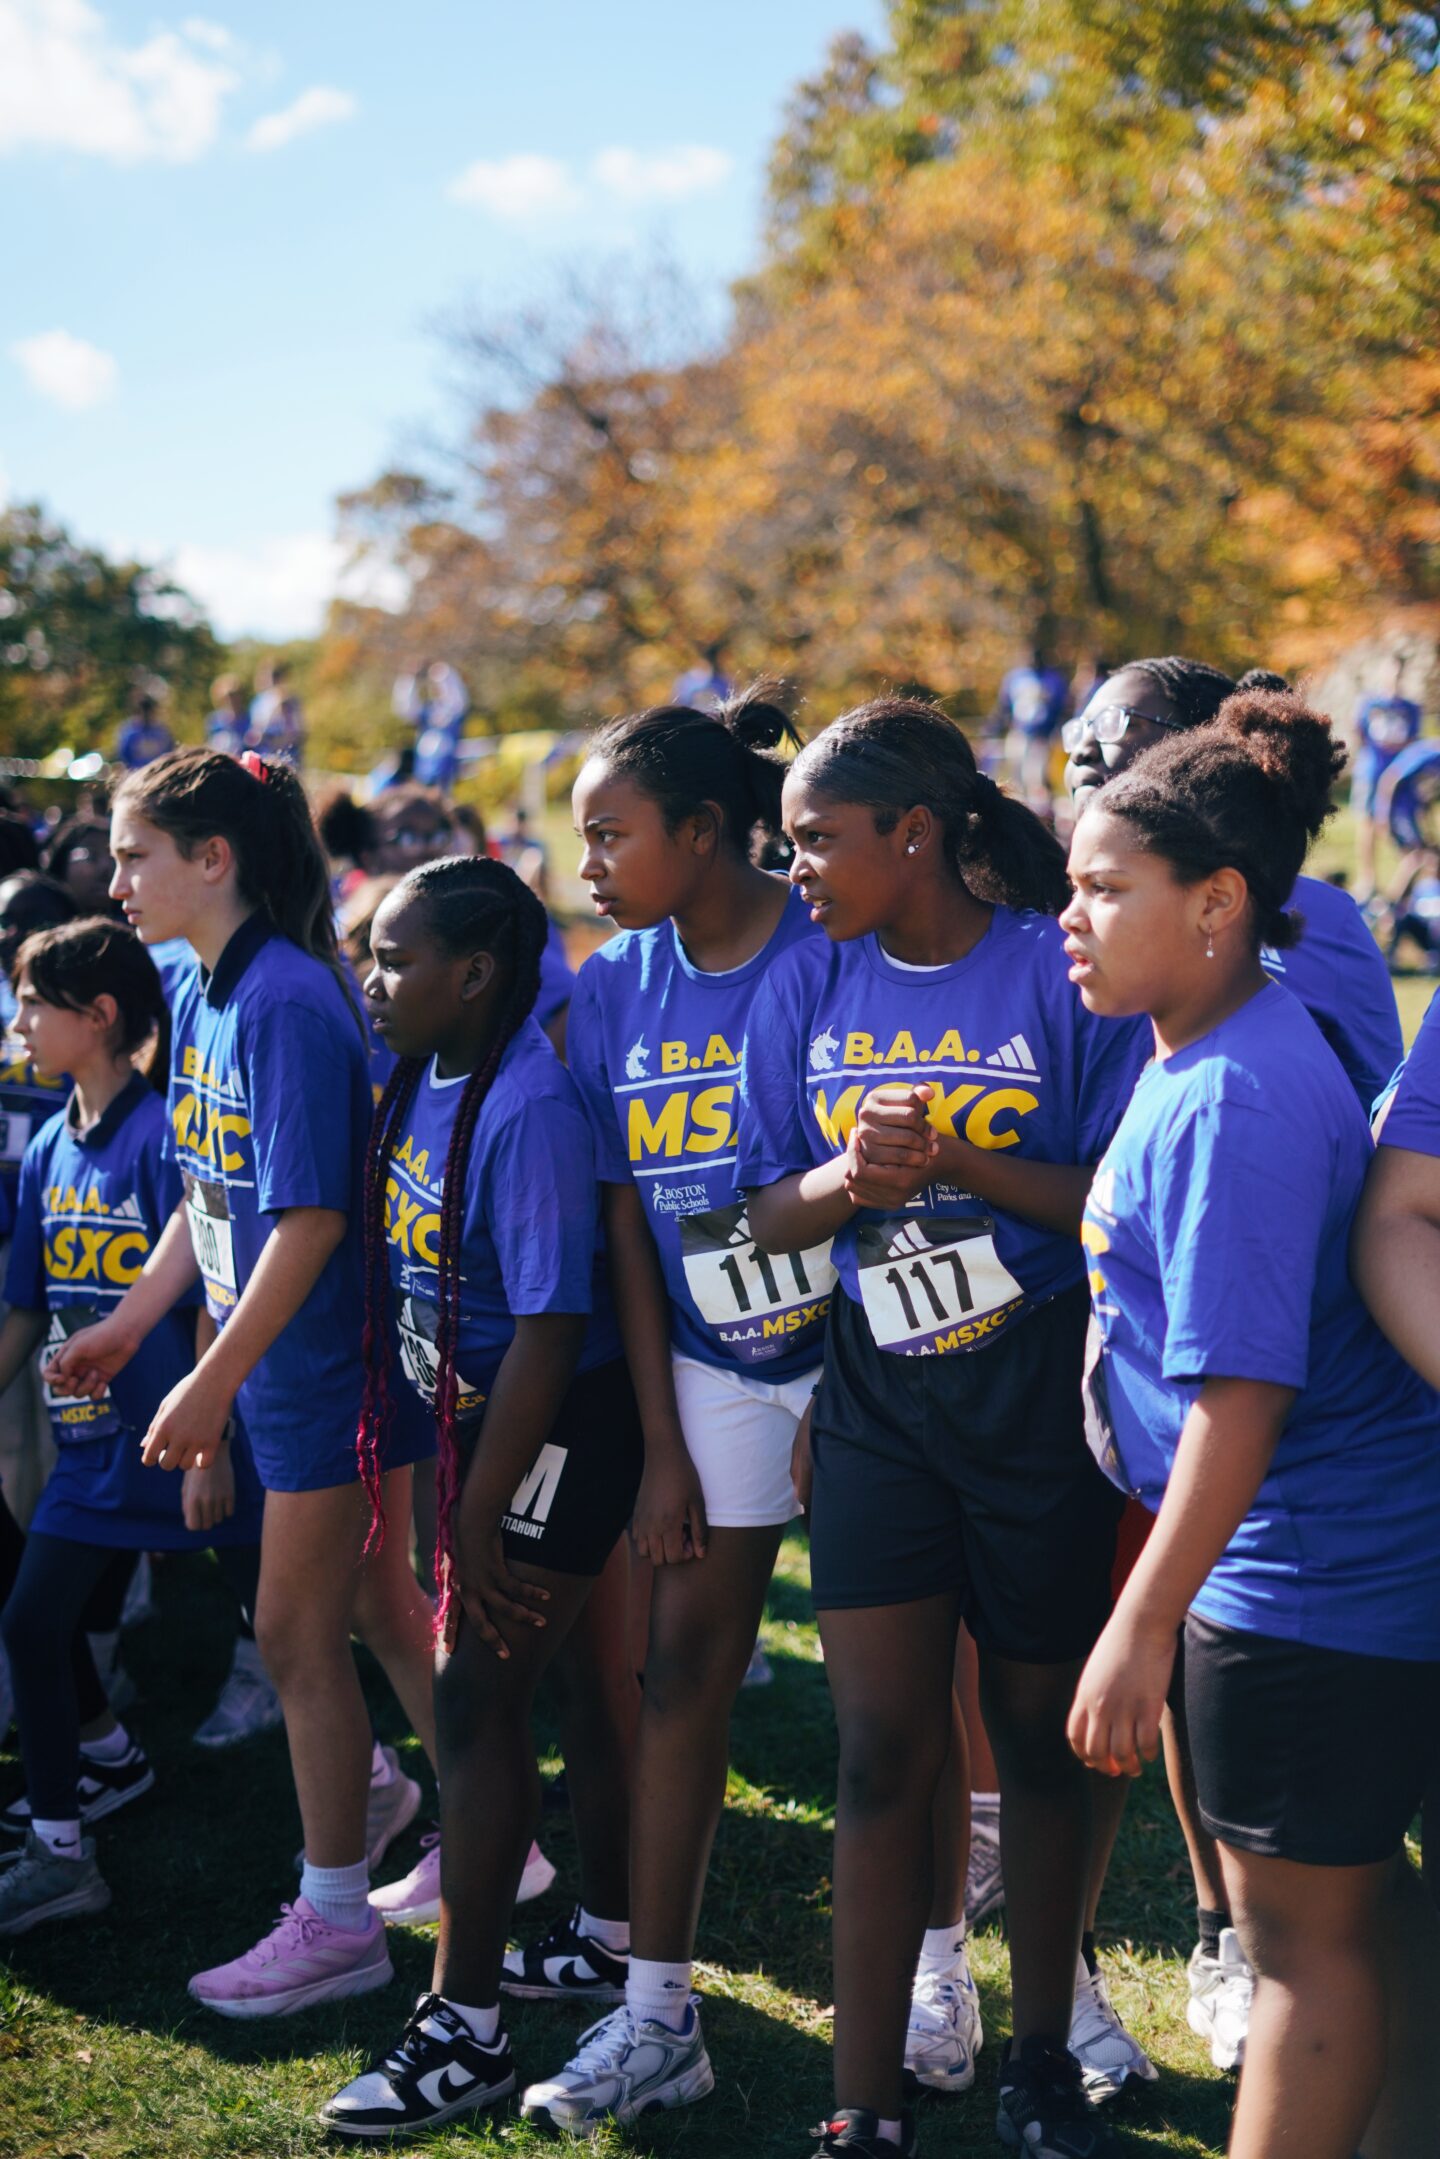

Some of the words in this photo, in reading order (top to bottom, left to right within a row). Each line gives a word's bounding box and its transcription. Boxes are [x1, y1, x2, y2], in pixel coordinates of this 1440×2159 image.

[661, 1034, 743, 1074] B.A.
[843, 1029, 980, 1065] B.A.A.
[628, 1082, 738, 1161] MS
[814, 1082, 1040, 1150] MXC
[659, 1199, 681, 1211] Public
[680, 1196, 710, 1210] Schools
[664, 1184, 706, 1200] BOSTON
[44, 1226, 150, 1284] SXC
[885, 1250, 974, 1330] 117
[719, 1327, 761, 1342] B.A.A.
[763, 1300, 831, 1339] MSXC
[934, 1309, 1008, 1355] MSXC
[501, 1515, 546, 1540] TTAHUNT
